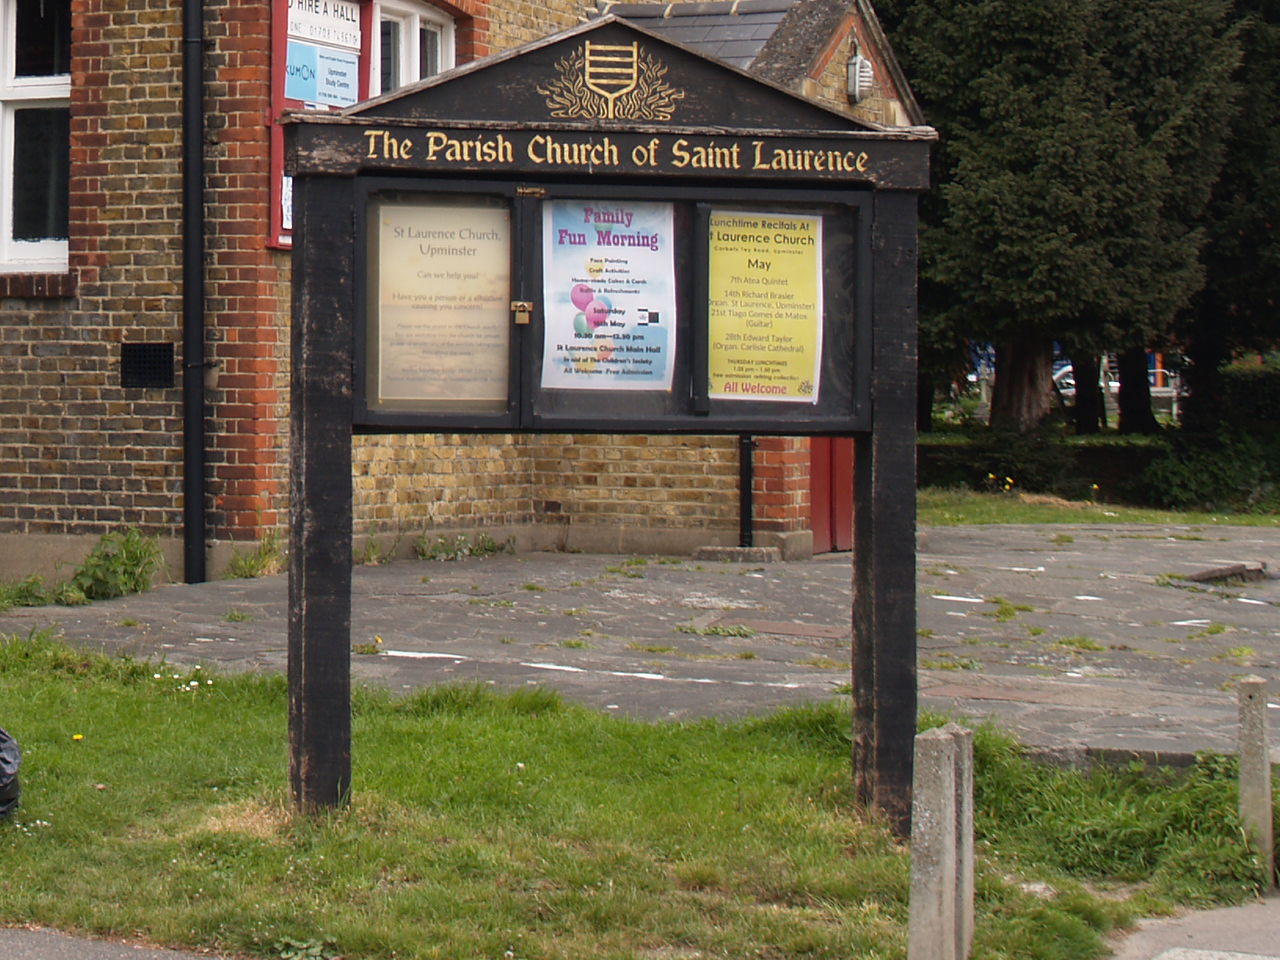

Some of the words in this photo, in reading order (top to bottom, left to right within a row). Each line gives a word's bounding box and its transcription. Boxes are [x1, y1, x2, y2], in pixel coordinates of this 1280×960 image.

[322, 1, 329, 16] A
[333, 2, 357, 23] HALL
[364, 130, 413, 160] The
[426, 131, 513, 163] Parish
[527, 134, 618, 166] Church
[631, 138, 660, 167] of
[671, 139, 740, 169] Saint
[751, 141, 868, 171] Laurence
[584, 207, 634, 228] Family
[709, 217, 759, 229] Lunchtime
[761, 220, 797, 230] Recitals
[799, 222, 810, 231] At
[394, 226, 405, 239] St
[408, 227, 456, 240] Laurence
[558, 229, 587, 246] Fun
[596, 231, 659, 251] Morning
[716, 231, 771, 244] Laurence
[773, 233, 815, 246] Church
[419, 244, 478, 259] Upminster
[747, 258, 772, 272] May
[593, 307, 625, 315] Saturday
[609, 320, 625, 328] May
[565, 344, 597, 352] Laurence
[599, 344, 625, 352] Church
[723, 381, 738, 393] All
[741, 382, 788, 395] Welcome
